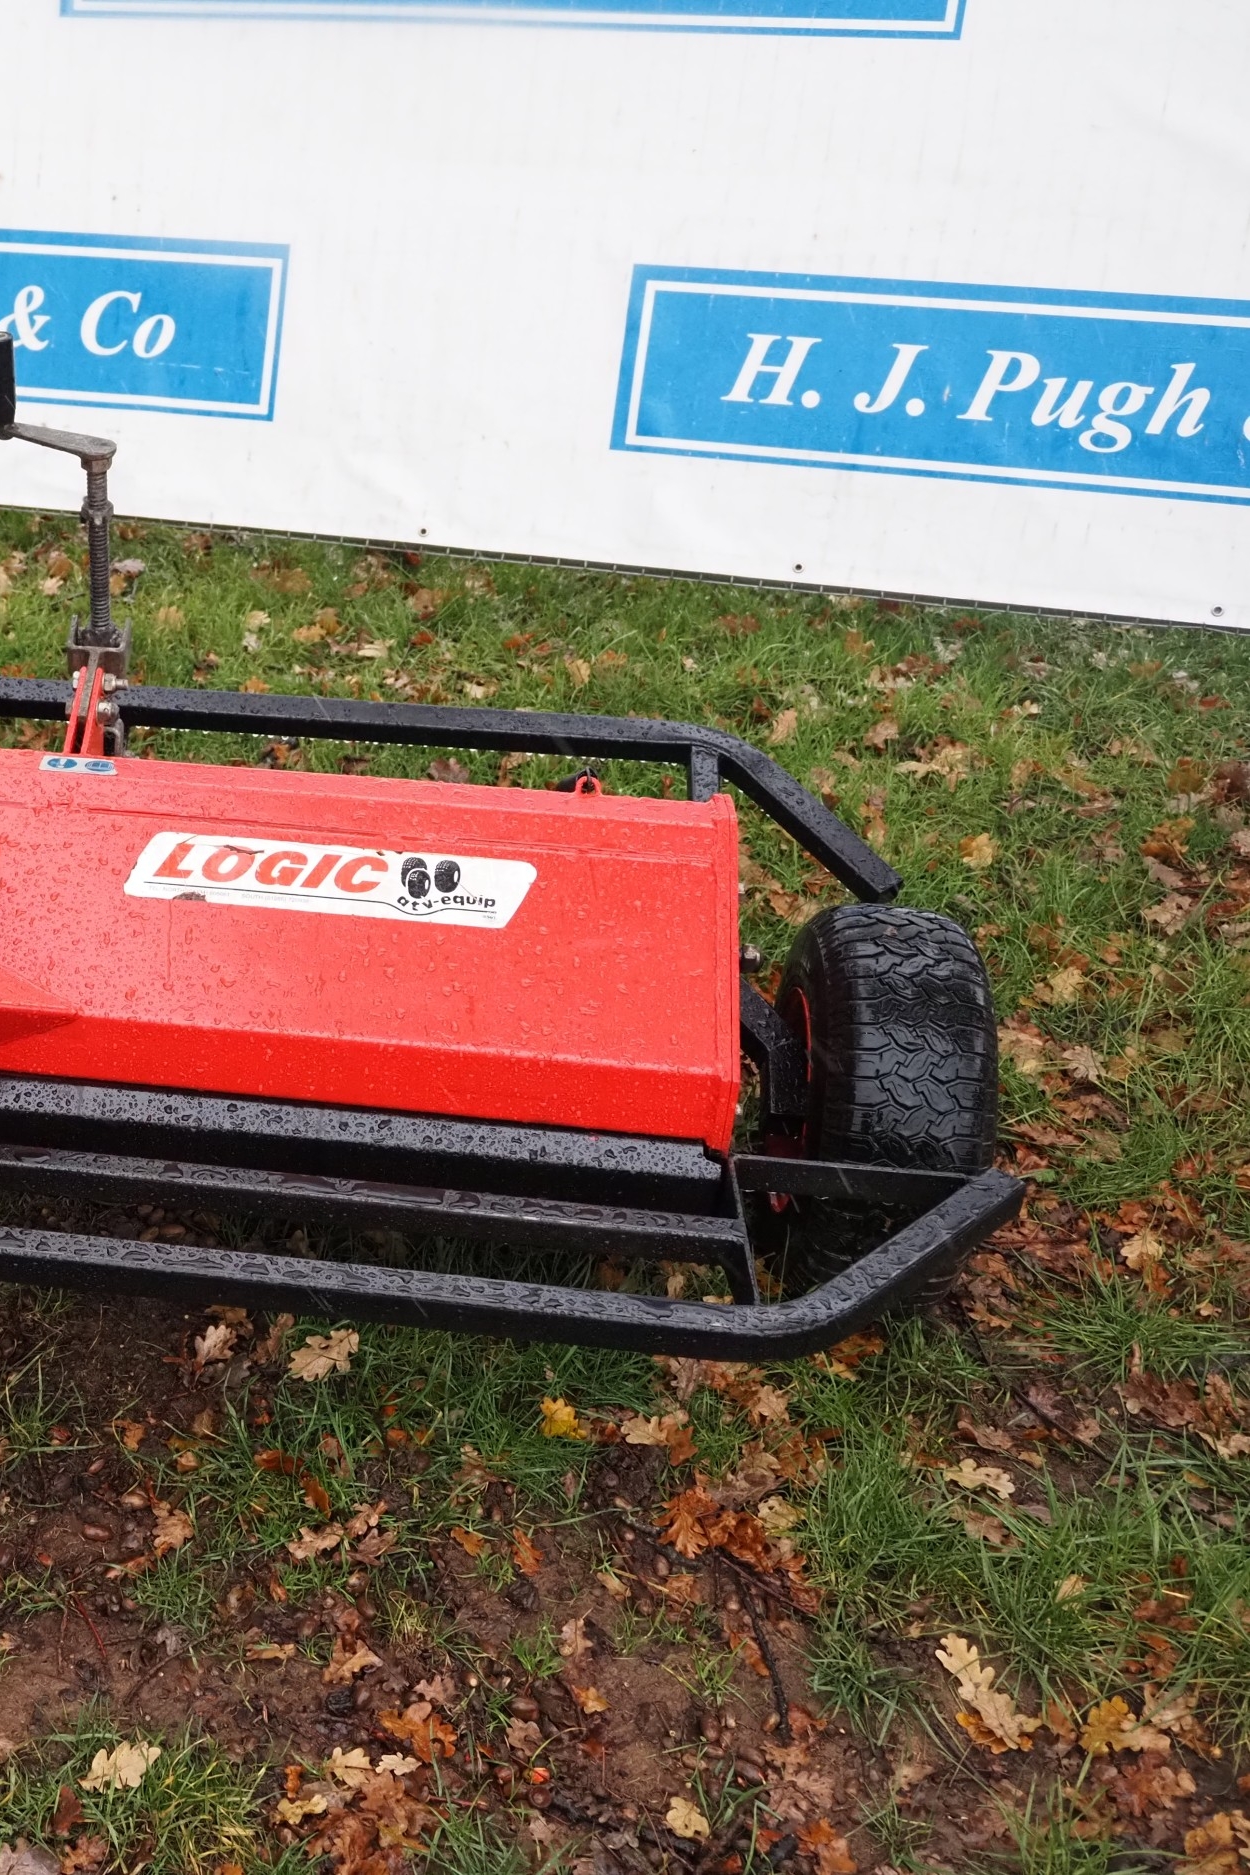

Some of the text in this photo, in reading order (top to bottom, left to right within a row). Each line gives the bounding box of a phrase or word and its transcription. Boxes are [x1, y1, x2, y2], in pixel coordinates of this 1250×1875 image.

[80, 290, 177, 359] Co
[720, 332, 1212, 454] H. J. Pugh
[152, 842, 389, 893] LOGIC
